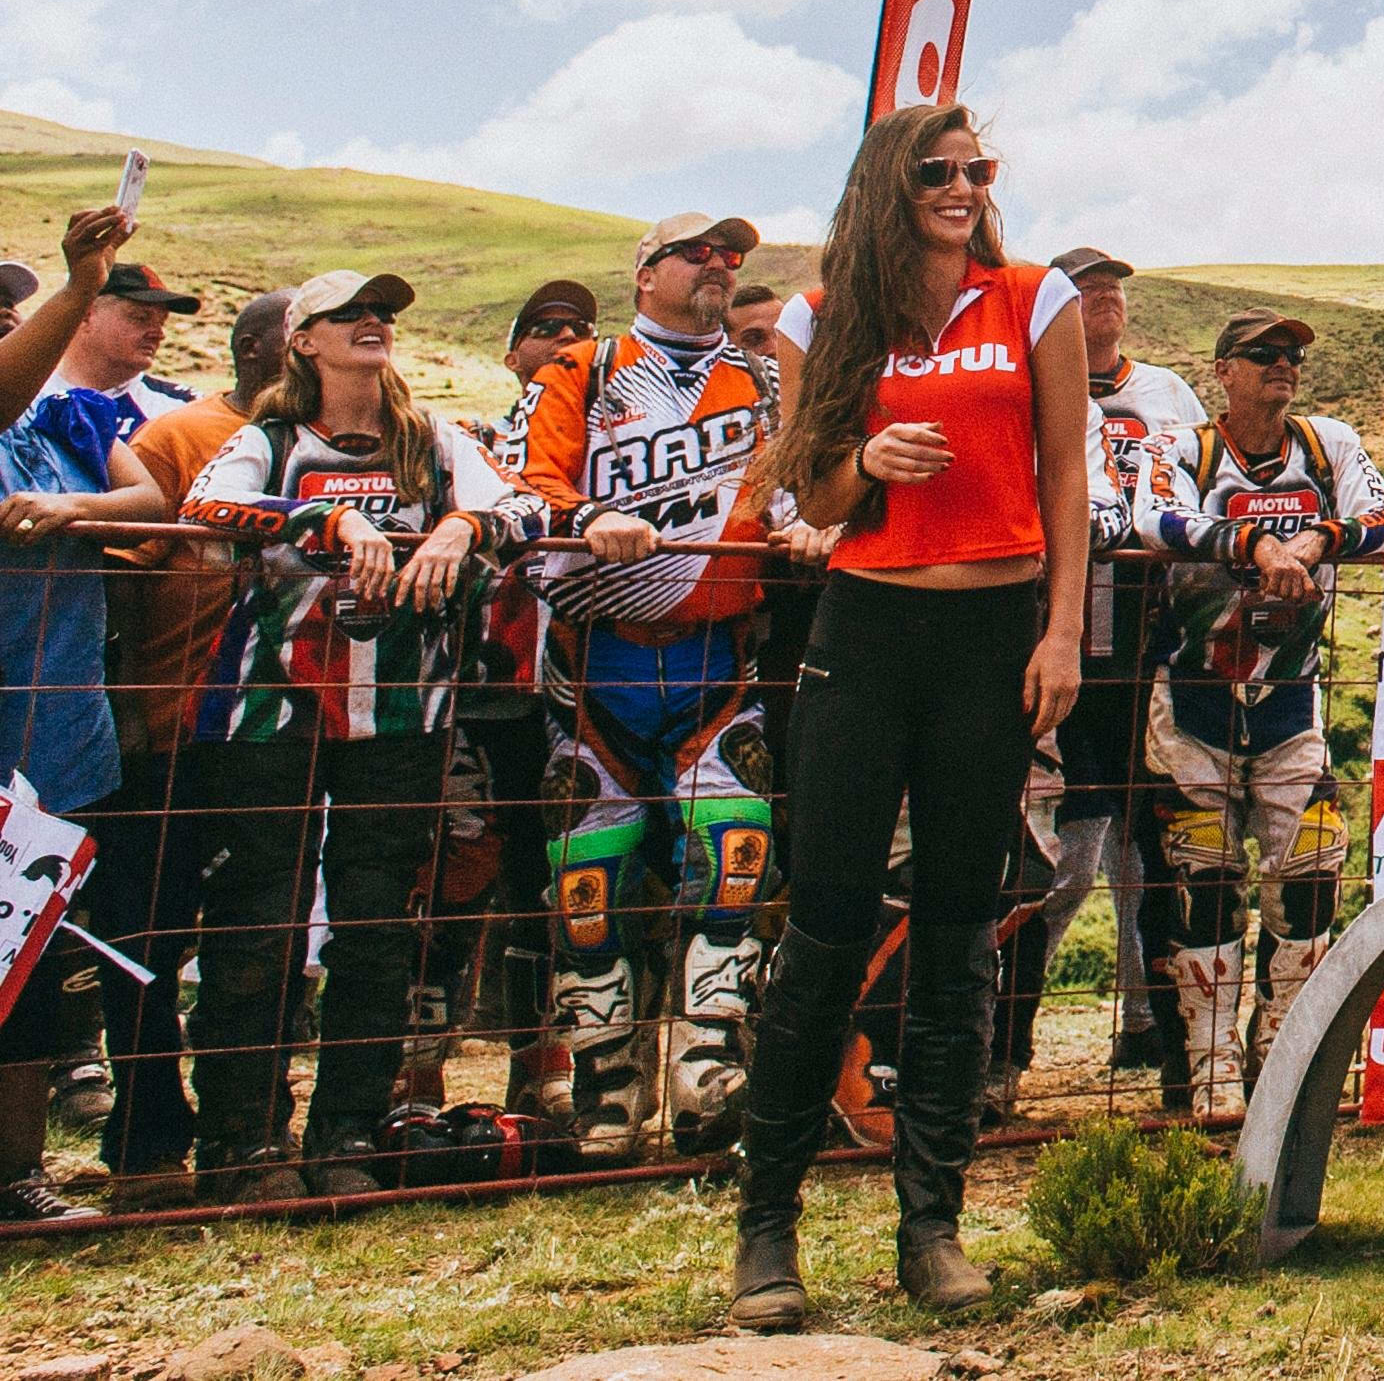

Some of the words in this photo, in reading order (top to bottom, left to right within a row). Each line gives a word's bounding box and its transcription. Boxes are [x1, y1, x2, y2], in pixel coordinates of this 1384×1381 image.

[589, 406, 757, 502] RAD
[322, 475, 397, 494] MOTUL
[177, 499, 289, 535] MOTO
[1247, 496, 1303, 513] MOTUL
